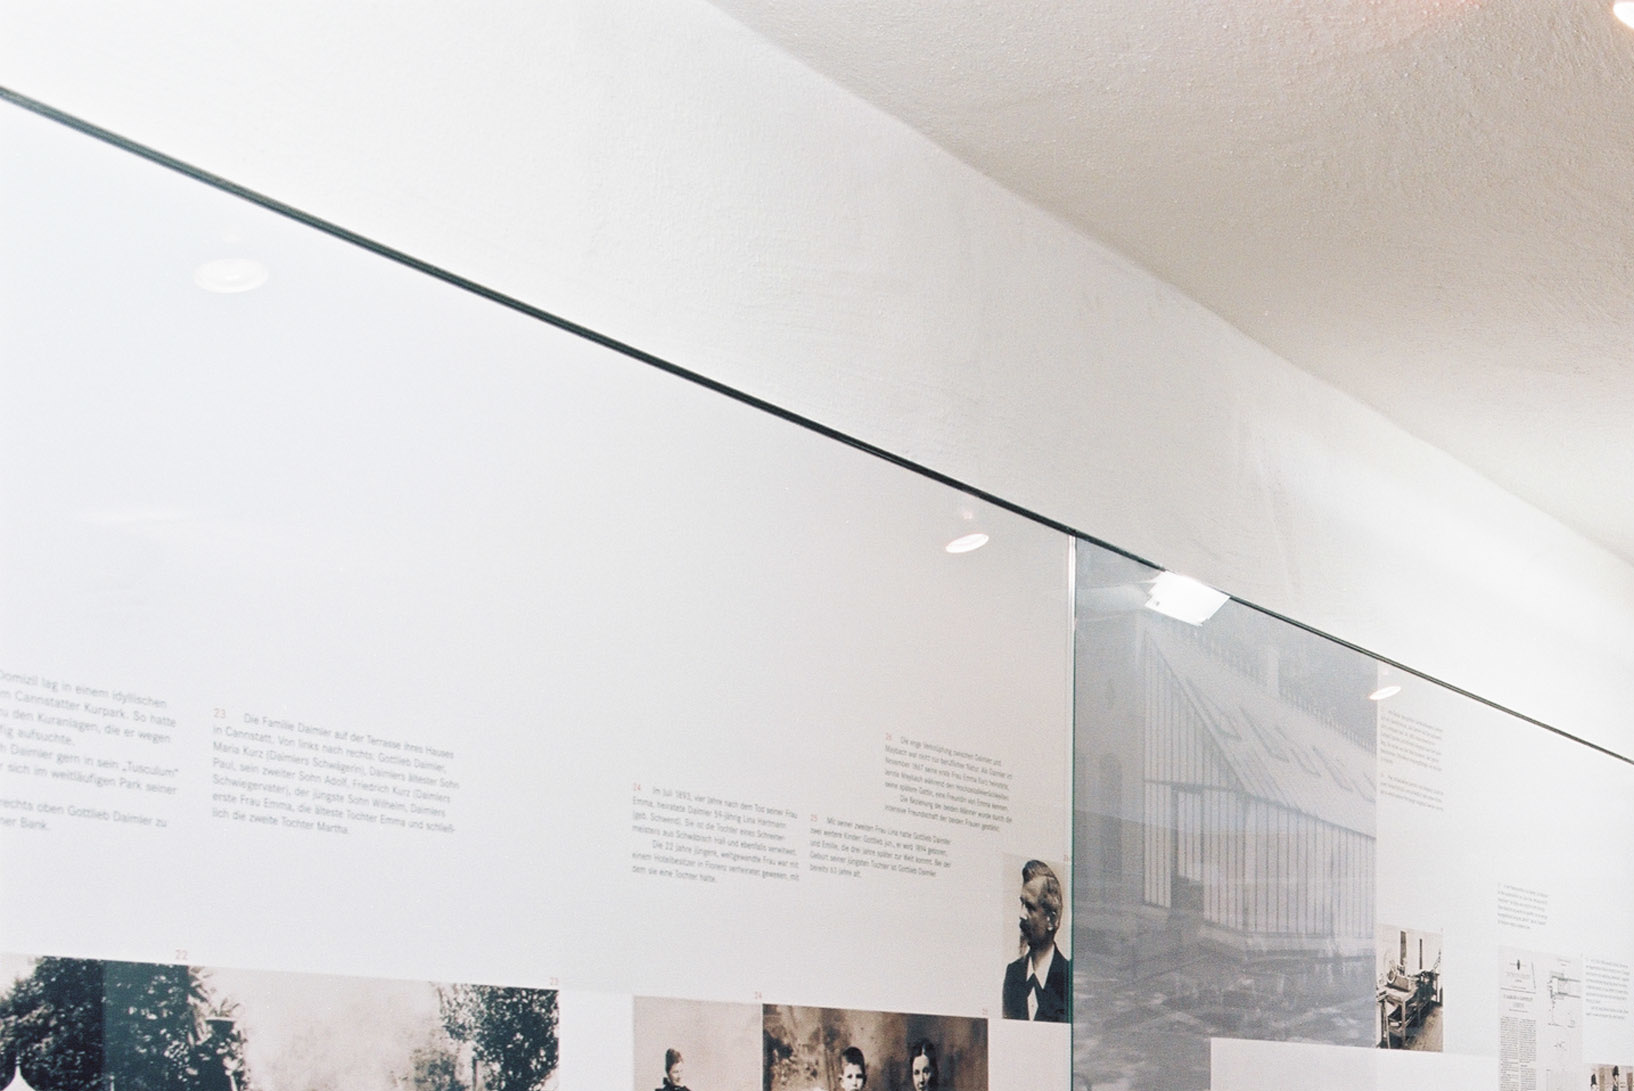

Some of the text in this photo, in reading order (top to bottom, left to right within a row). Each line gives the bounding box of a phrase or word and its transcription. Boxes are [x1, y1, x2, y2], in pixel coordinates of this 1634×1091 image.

[42, 678, 58, 693] lag
[62, 681, 72, 692] in
[76, 685, 108, 697] einem
[112, 691, 166, 708] idyllischen
[16, 690, 80, 711] Cannstatter
[84, 703, 128, 719] Kurpark.
[132, 710, 146, 723] So
[150, 715, 176, 728] hatte
[12, 709, 34, 721] den
[38, 713, 100, 734] Kuranlagen,
[104, 724, 120, 736] die
[124, 729, 134, 738] er
[138, 732, 170, 744] wegen
[10, 743, 52, 760] Daimler
[56, 753, 80, 765] gern
[84, 757, 92, 766] in
[98, 759, 118, 769] sein
[8, 764, 30, 775] sich
[34, 768, 48, 777] im
[52, 770, 116, 788] weitläufigen
[120, 777, 142, 790] Park
[146, 784, 178, 795] seiner
[20, 817, 50, 831] Bank.
[38, 803, 64, 814] oben
[68, 805, 110, 821] Gottlieb
[114, 810, 152, 826] Daimler
[156, 819, 168, 828] zu
